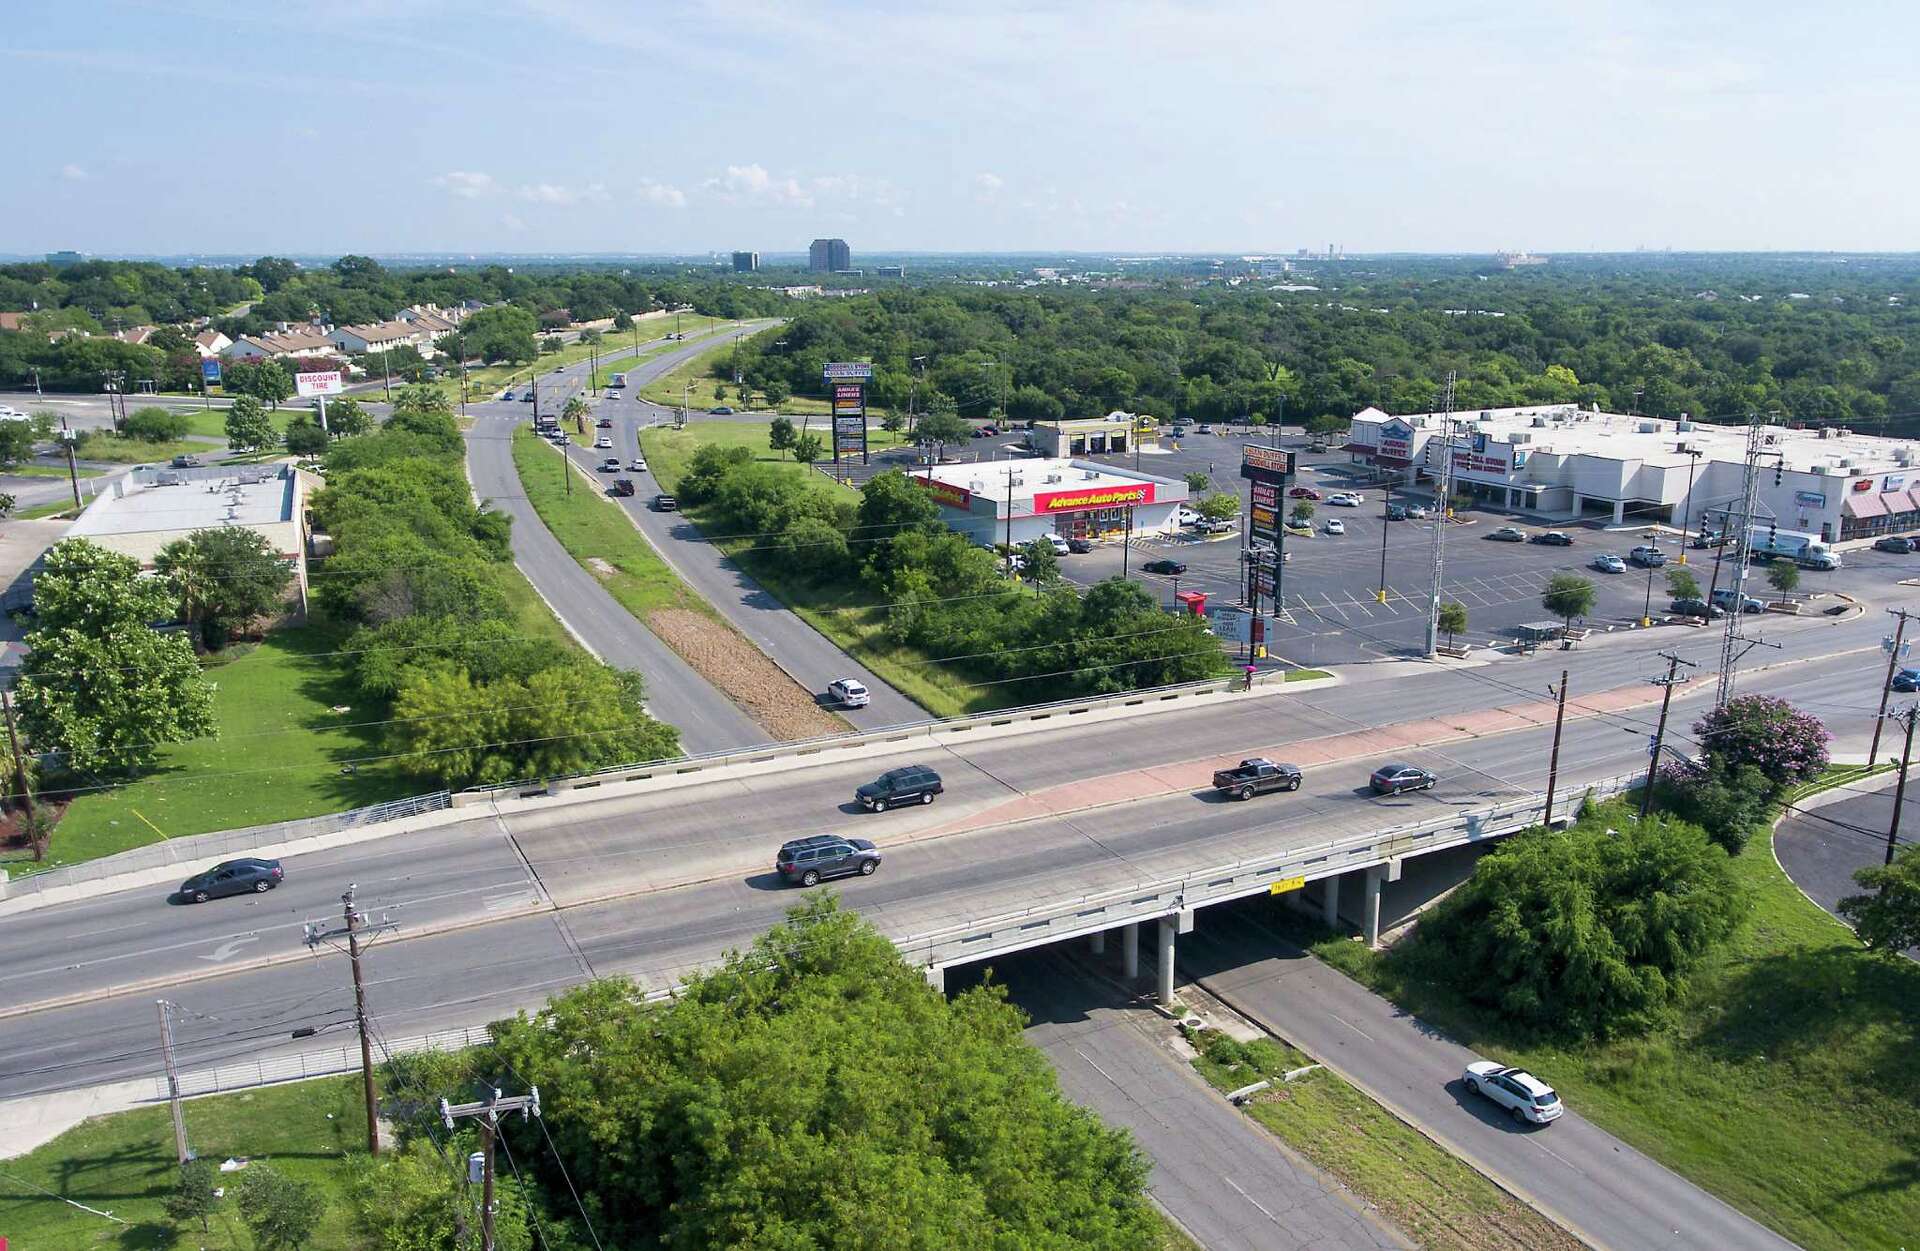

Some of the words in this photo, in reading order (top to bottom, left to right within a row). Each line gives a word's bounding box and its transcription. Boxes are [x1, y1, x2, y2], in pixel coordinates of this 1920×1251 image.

[299, 374, 337, 383] DISCOUNT
[1253, 485, 1275, 497] ANNA'S
[1048, 497, 1089, 509] Advance
[1088, 494, 1112, 505] Auto
[1112, 491, 1137, 502] Parts
[1253, 495, 1275, 507] LINENS
